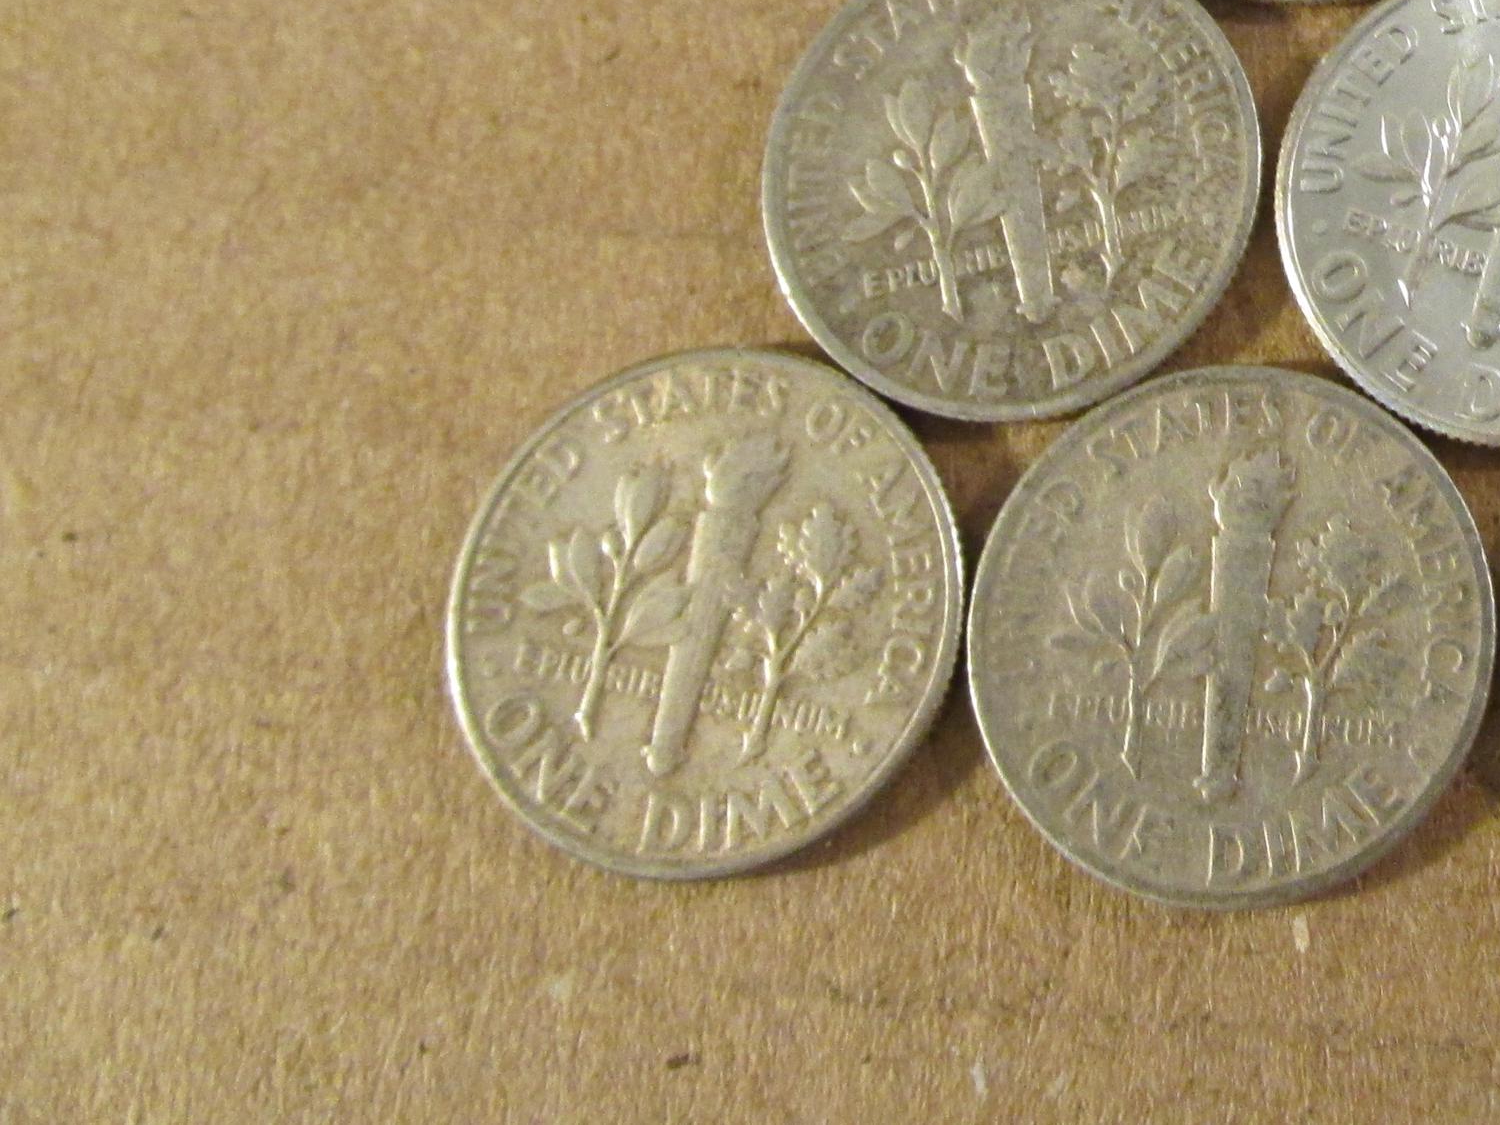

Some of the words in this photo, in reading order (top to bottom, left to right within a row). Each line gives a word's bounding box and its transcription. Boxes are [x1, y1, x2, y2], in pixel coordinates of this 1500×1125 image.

[1300, 23, 1419, 195] UNITED
[862, 312, 1008, 397] ONE
[1041, 241, 1210, 391] DIME
[1310, 250, 1440, 394] ONE
[592, 370, 791, 444] STATES
[805, 399, 874, 455] OF
[484, 695, 614, 836] ONE
[637, 747, 845, 856] DIME
[1203, 763, 1404, 889] DIME
